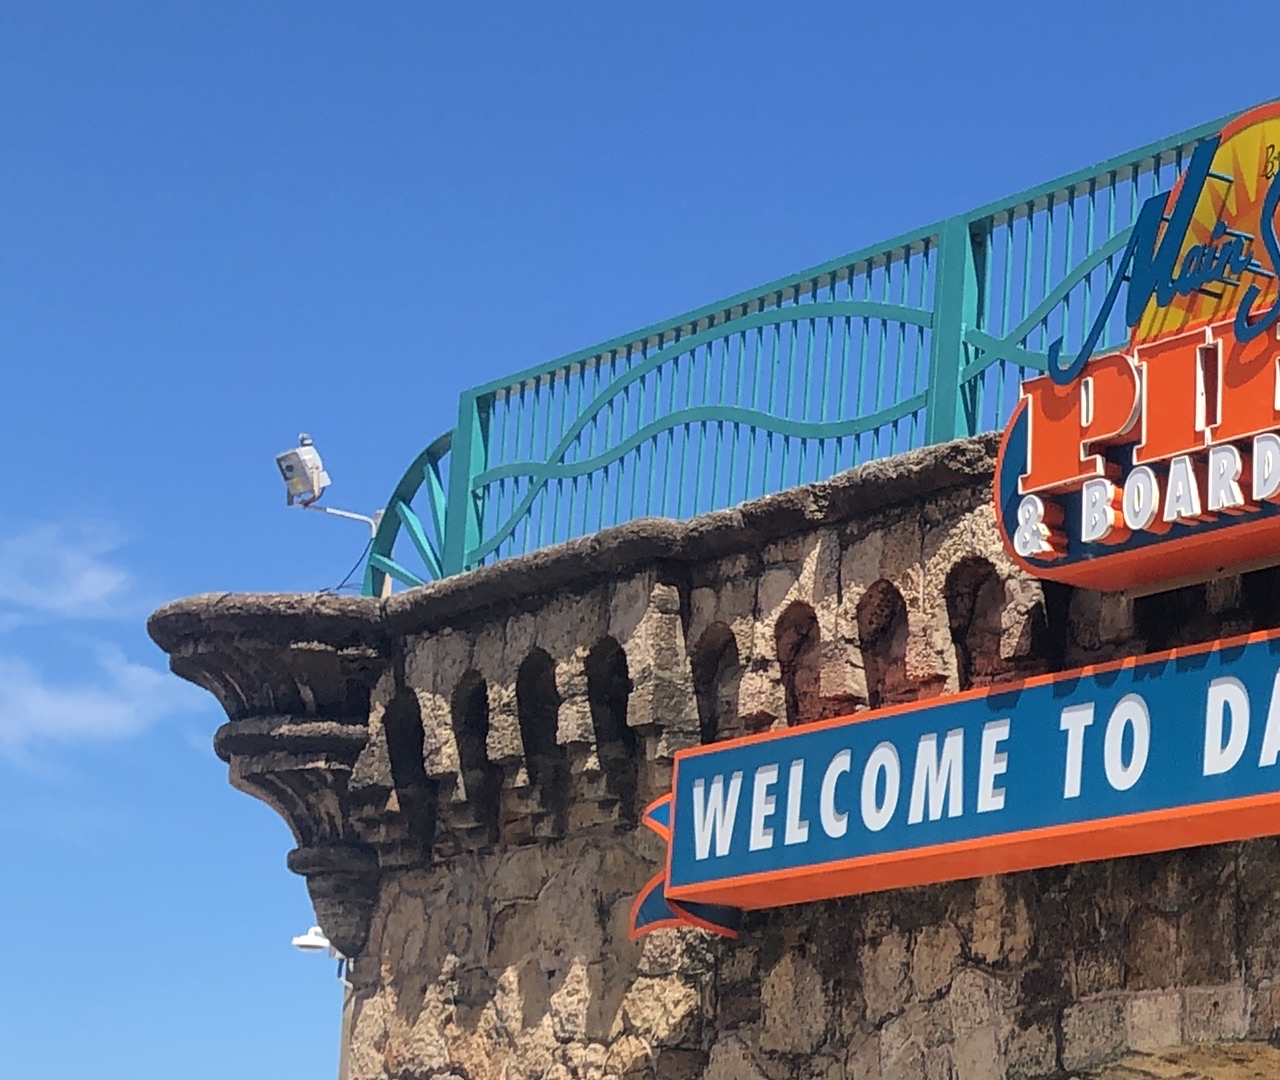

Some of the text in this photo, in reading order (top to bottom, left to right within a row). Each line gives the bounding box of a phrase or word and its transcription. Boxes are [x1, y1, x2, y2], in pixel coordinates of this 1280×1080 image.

[1049, 136, 1250, 385] Main
[1014, 495, 1051, 558] &
[692, 718, 1012, 861] WELCOME
[1059, 692, 1152, 800] TO
